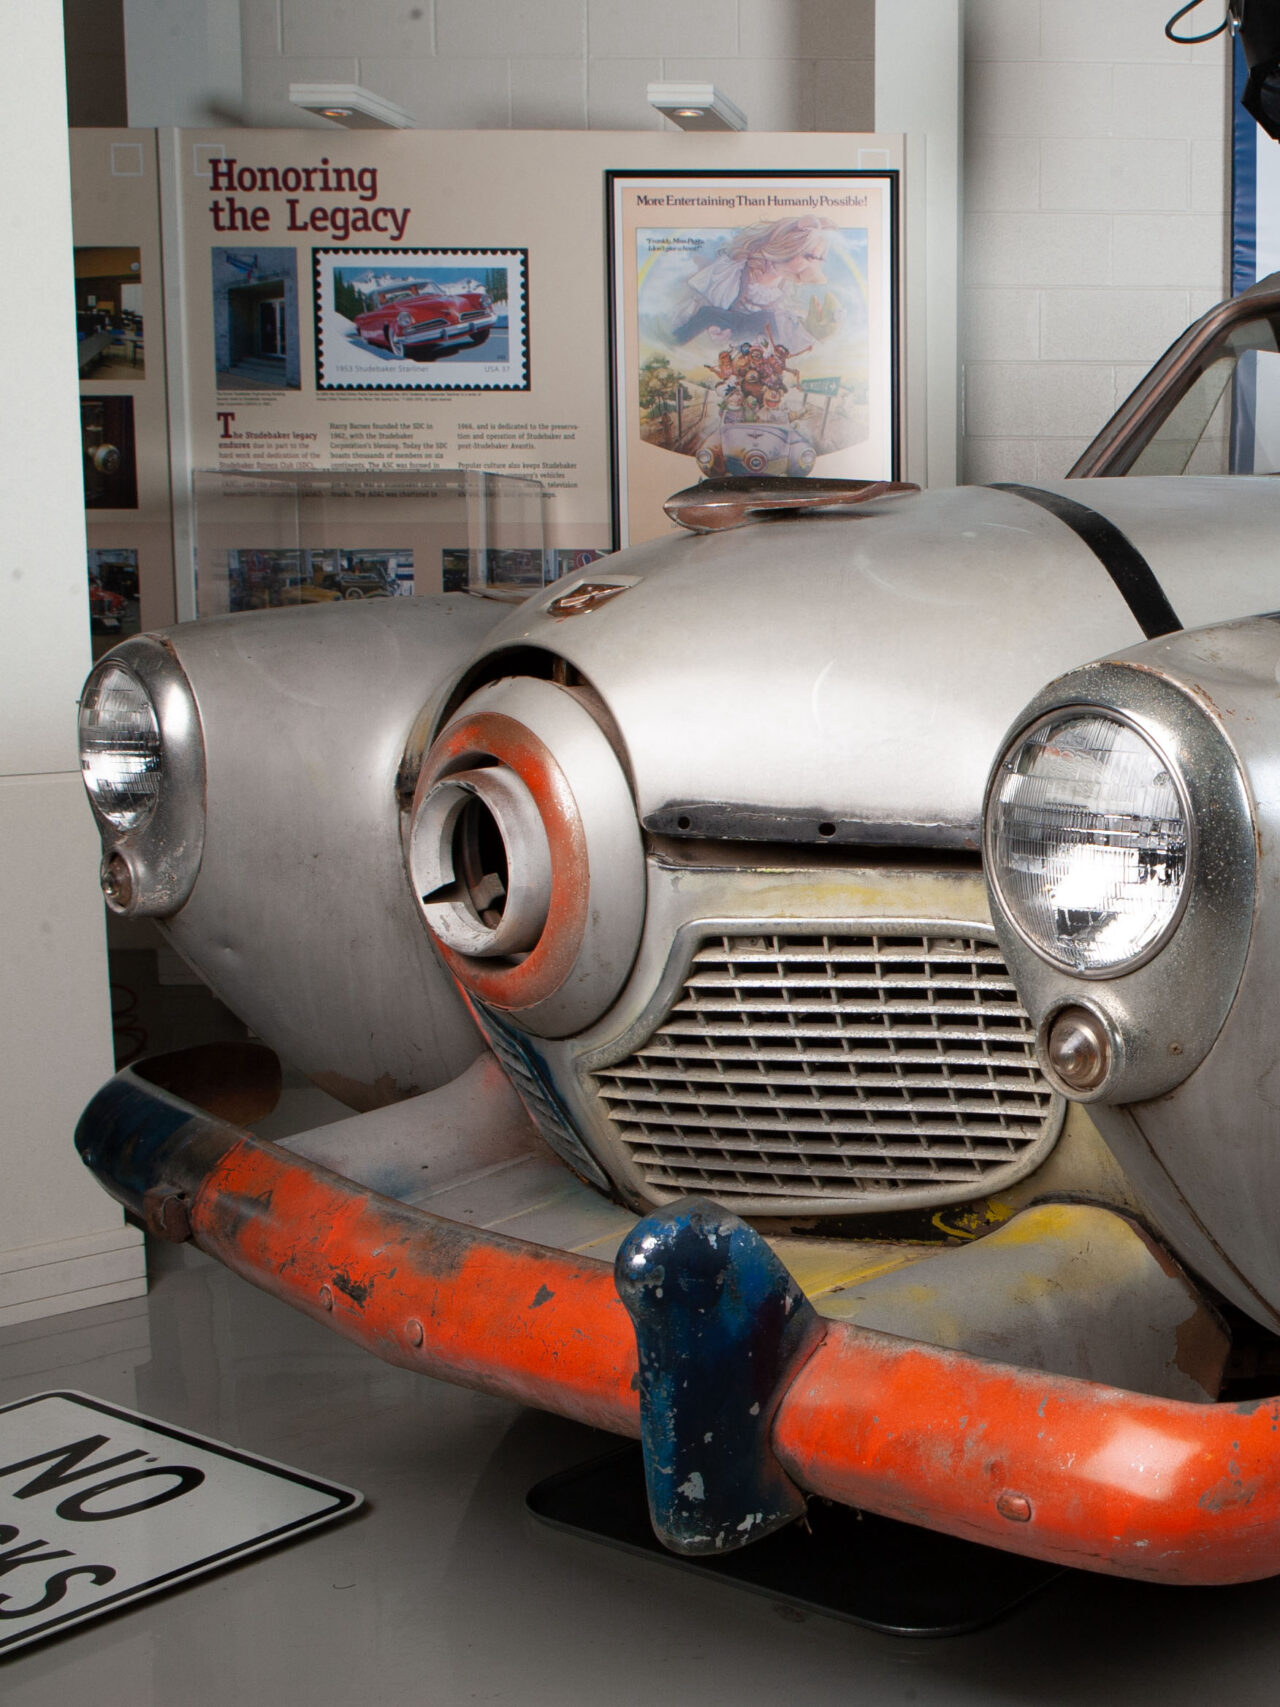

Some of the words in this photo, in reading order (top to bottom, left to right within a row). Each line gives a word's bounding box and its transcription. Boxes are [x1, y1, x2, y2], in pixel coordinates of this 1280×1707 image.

[208, 157, 378, 202] Honoring
[636, 195, 666, 207] More
[666, 195, 735, 208] Entertaining
[735, 195, 766, 207] Than
[767, 195, 819, 208] Humanly
[819, 195, 868, 207] Possible!
[208, 197, 271, 232] the
[285, 198, 411, 242] Legacy
[336, 365, 353, 374] 1953
[355, 365, 396, 374] Studebaker
[398, 365, 429, 374] Starliner
[484, 366, 500, 374] USA
[245, 431, 291, 440] Studebaker
[292, 431, 318, 441] legacy
[0, 1434, 206, 1522] NO
